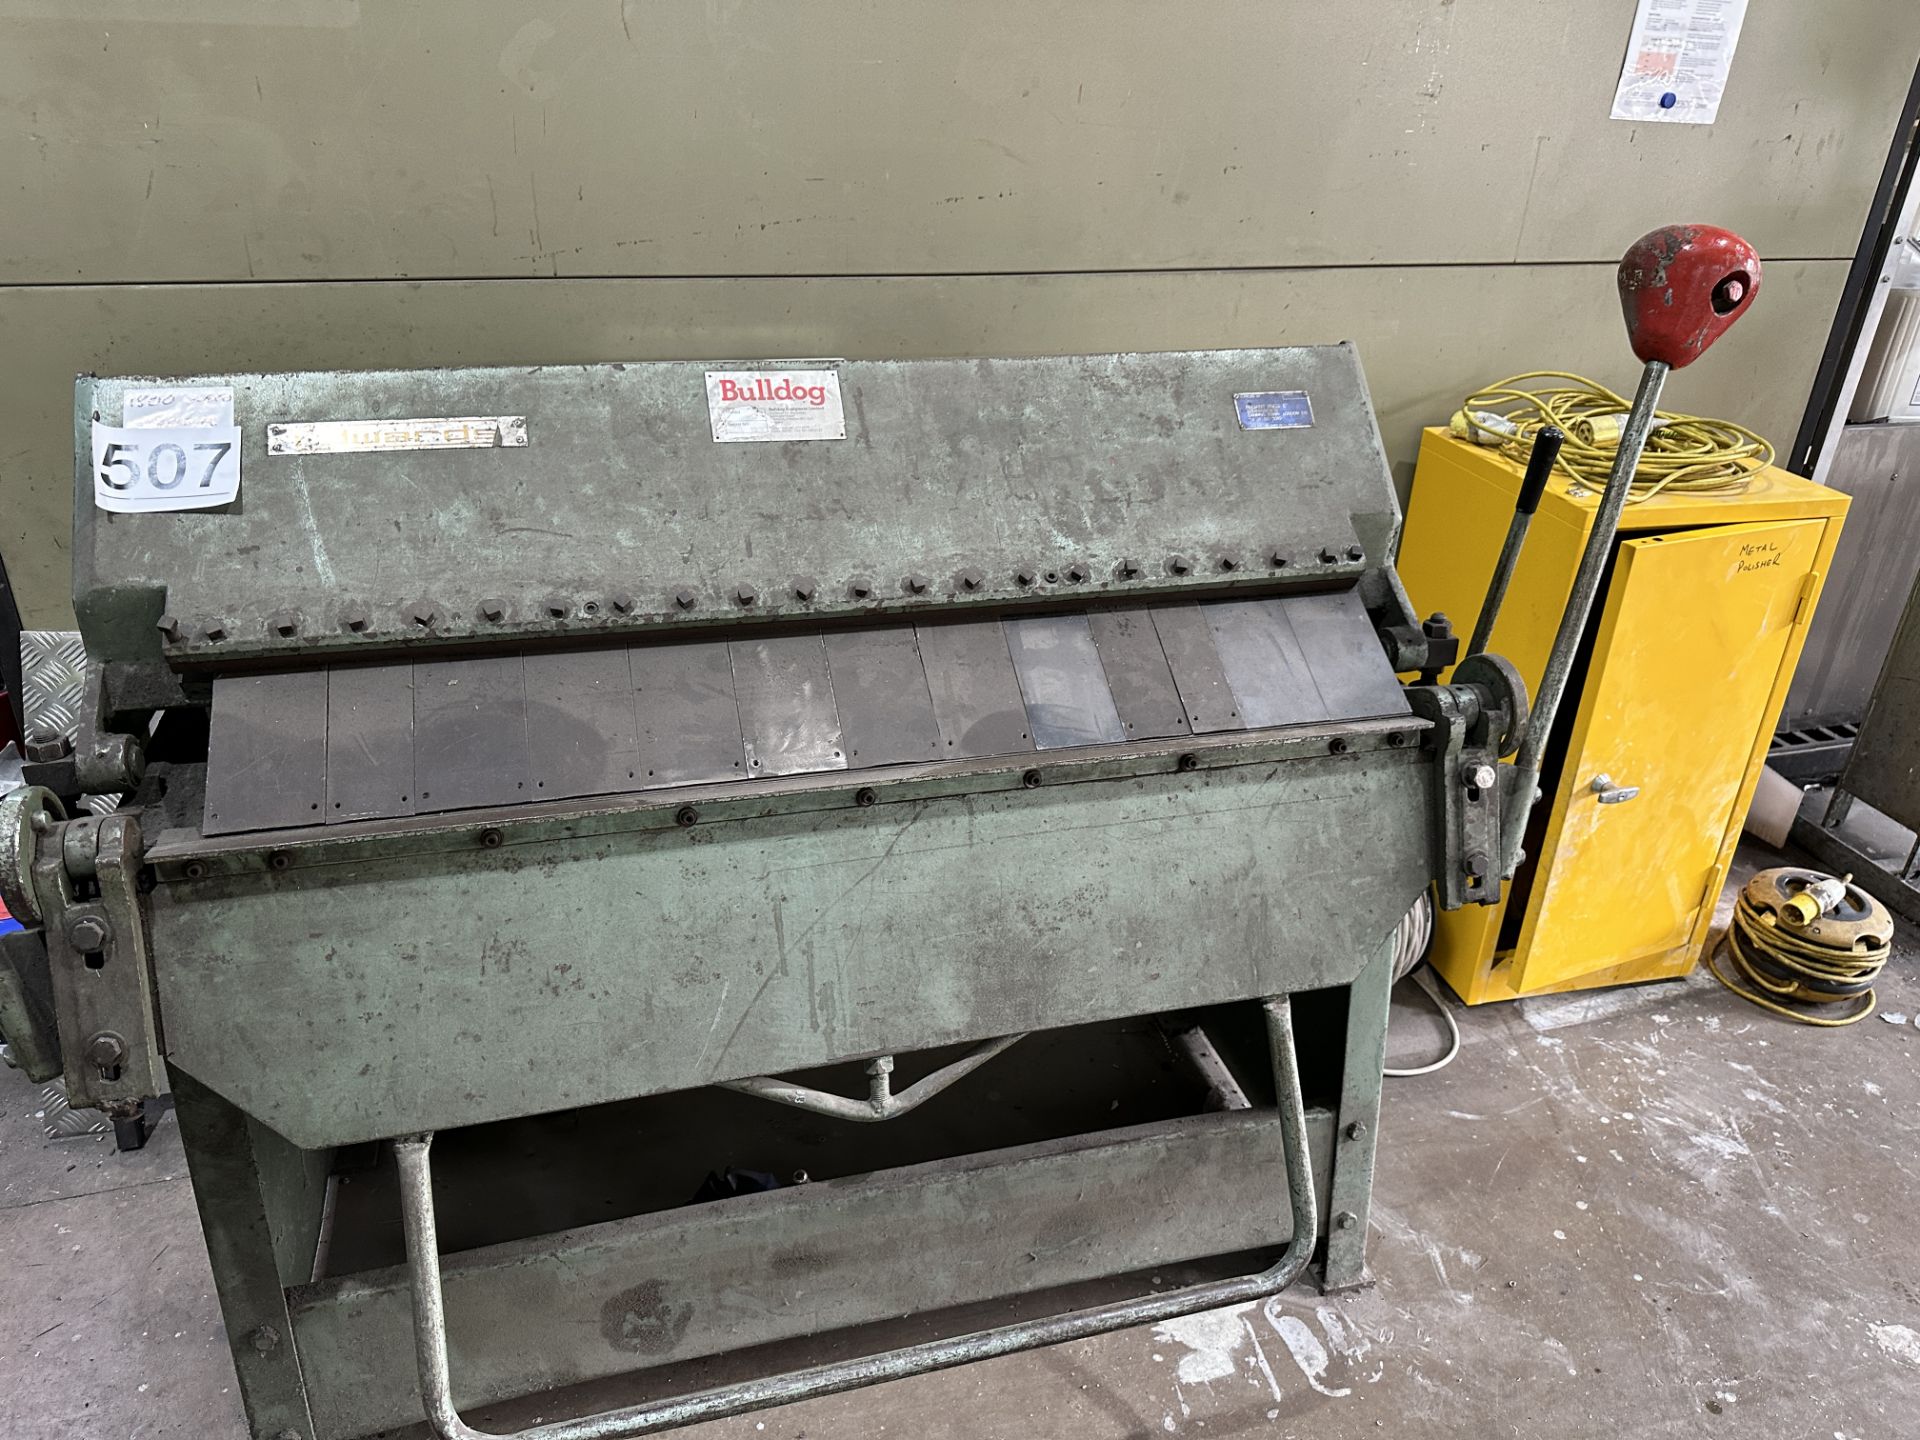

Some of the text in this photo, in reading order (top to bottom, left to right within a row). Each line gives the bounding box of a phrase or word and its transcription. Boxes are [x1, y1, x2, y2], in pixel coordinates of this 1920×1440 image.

[719, 378, 826, 406] Bulldog
[100, 442, 232, 491] 507
[1739, 542, 1778, 556] METAL
[1737, 553, 1781, 573] POLISHER
